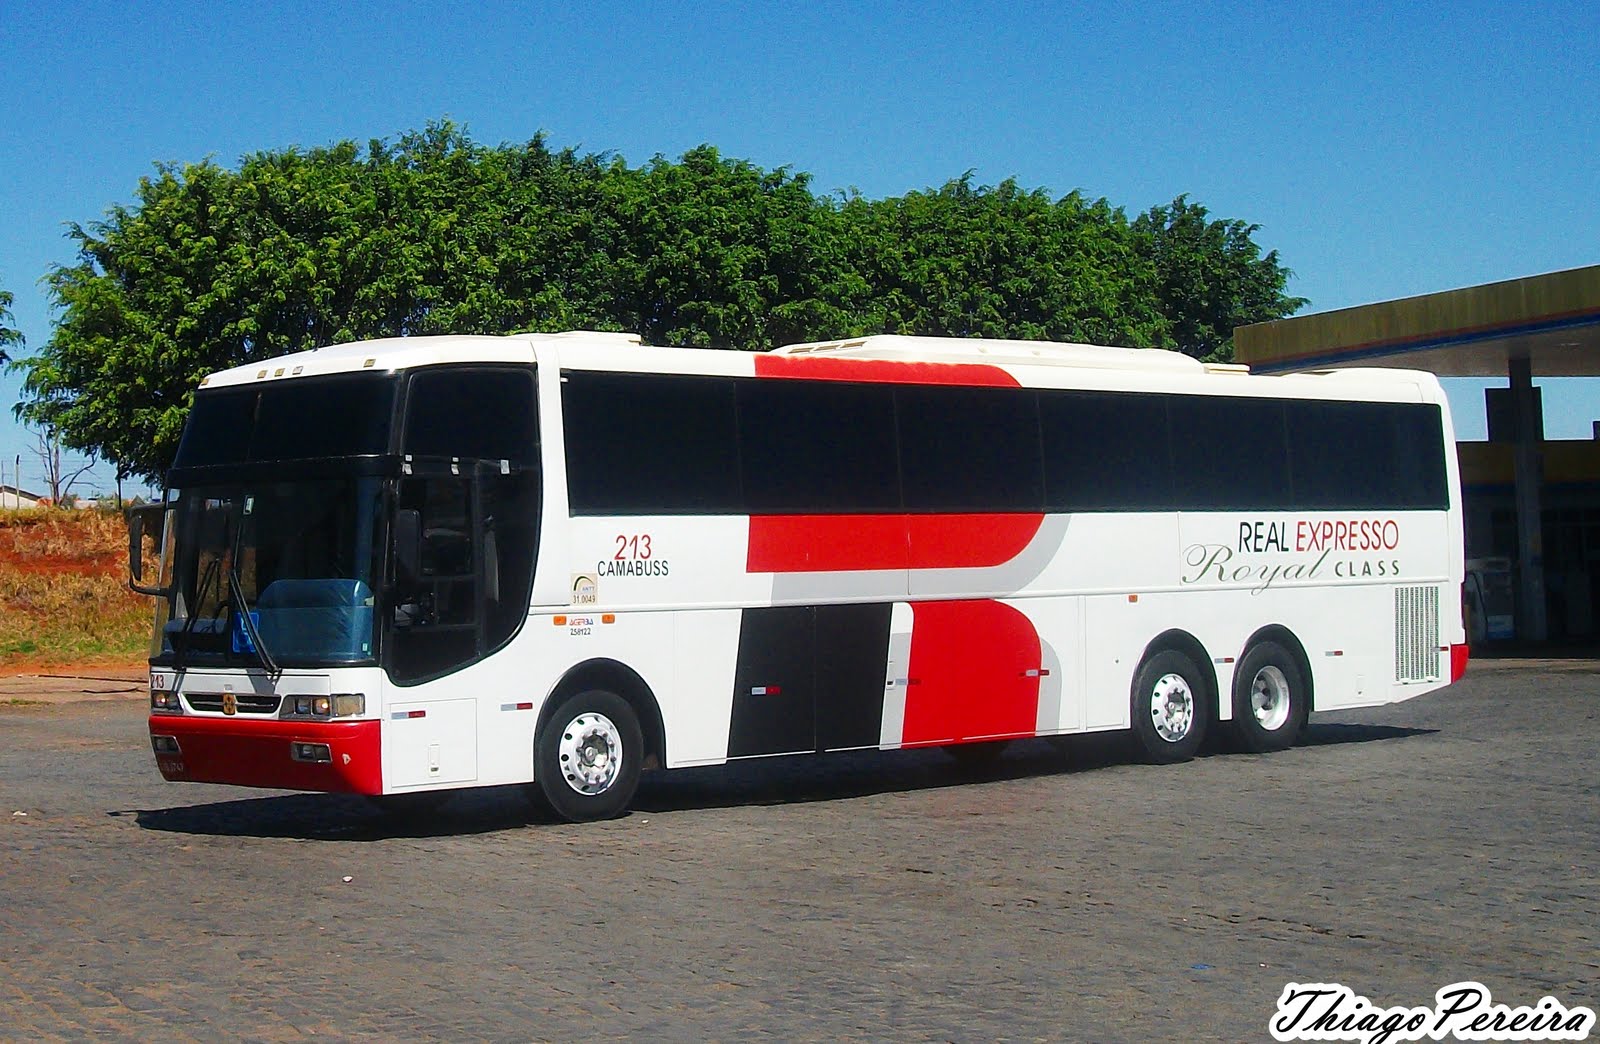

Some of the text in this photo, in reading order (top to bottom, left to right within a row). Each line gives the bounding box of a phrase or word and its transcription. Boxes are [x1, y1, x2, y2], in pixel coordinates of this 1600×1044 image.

[614, 534, 652, 560] 213
[1238, 519, 1399, 552] REAL EXPRESSO
[597, 559, 669, 577] CAMABUSS
[1182, 543, 1400, 597] Royal CLASS
[150, 674, 165, 689] 213
